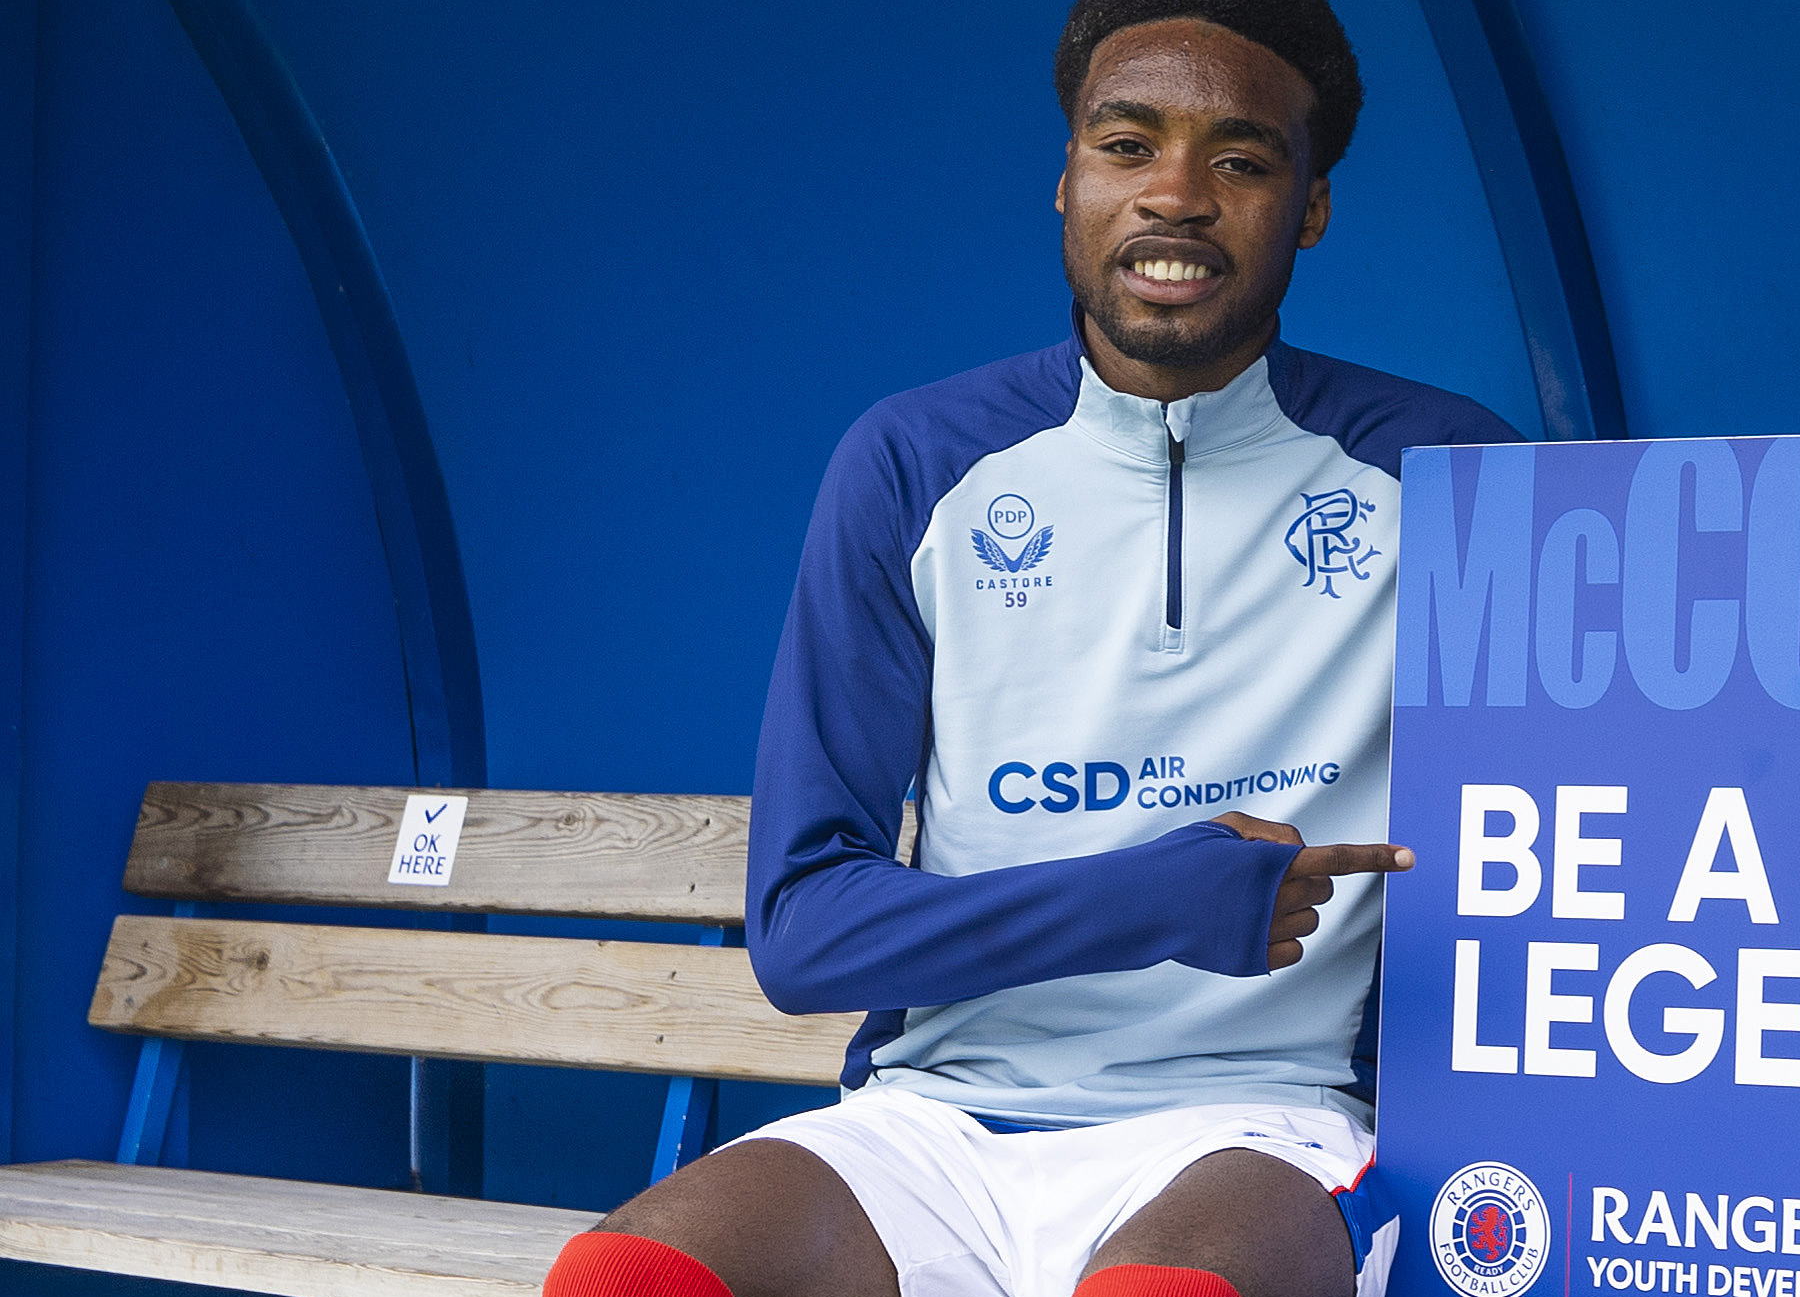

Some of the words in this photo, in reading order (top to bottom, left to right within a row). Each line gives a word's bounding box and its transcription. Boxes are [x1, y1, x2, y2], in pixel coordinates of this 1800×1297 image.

[993, 509, 1028, 524] PDP
[975, 575, 1054, 590] CASTORE
[1004, 592, 1028, 608] 59
[1138, 756, 1186, 780] AIR
[987, 760, 1132, 815] CSD
[1136, 762, 1341, 810] CONDITIONING
[413, 833, 441, 853] OK
[1456, 783, 1629, 921] BE
[1666, 786, 1781, 924] A
[398, 855, 446, 875] HERE
[1446, 1171, 1536, 1212] RANGERS
[1439, 1242, 1508, 1295] FOOTBALL
[1508, 1247, 1539, 1286] CLUB
[1472, 1264, 1504, 1276] READY
[1586, 1256, 1699, 1297] YOUTH
